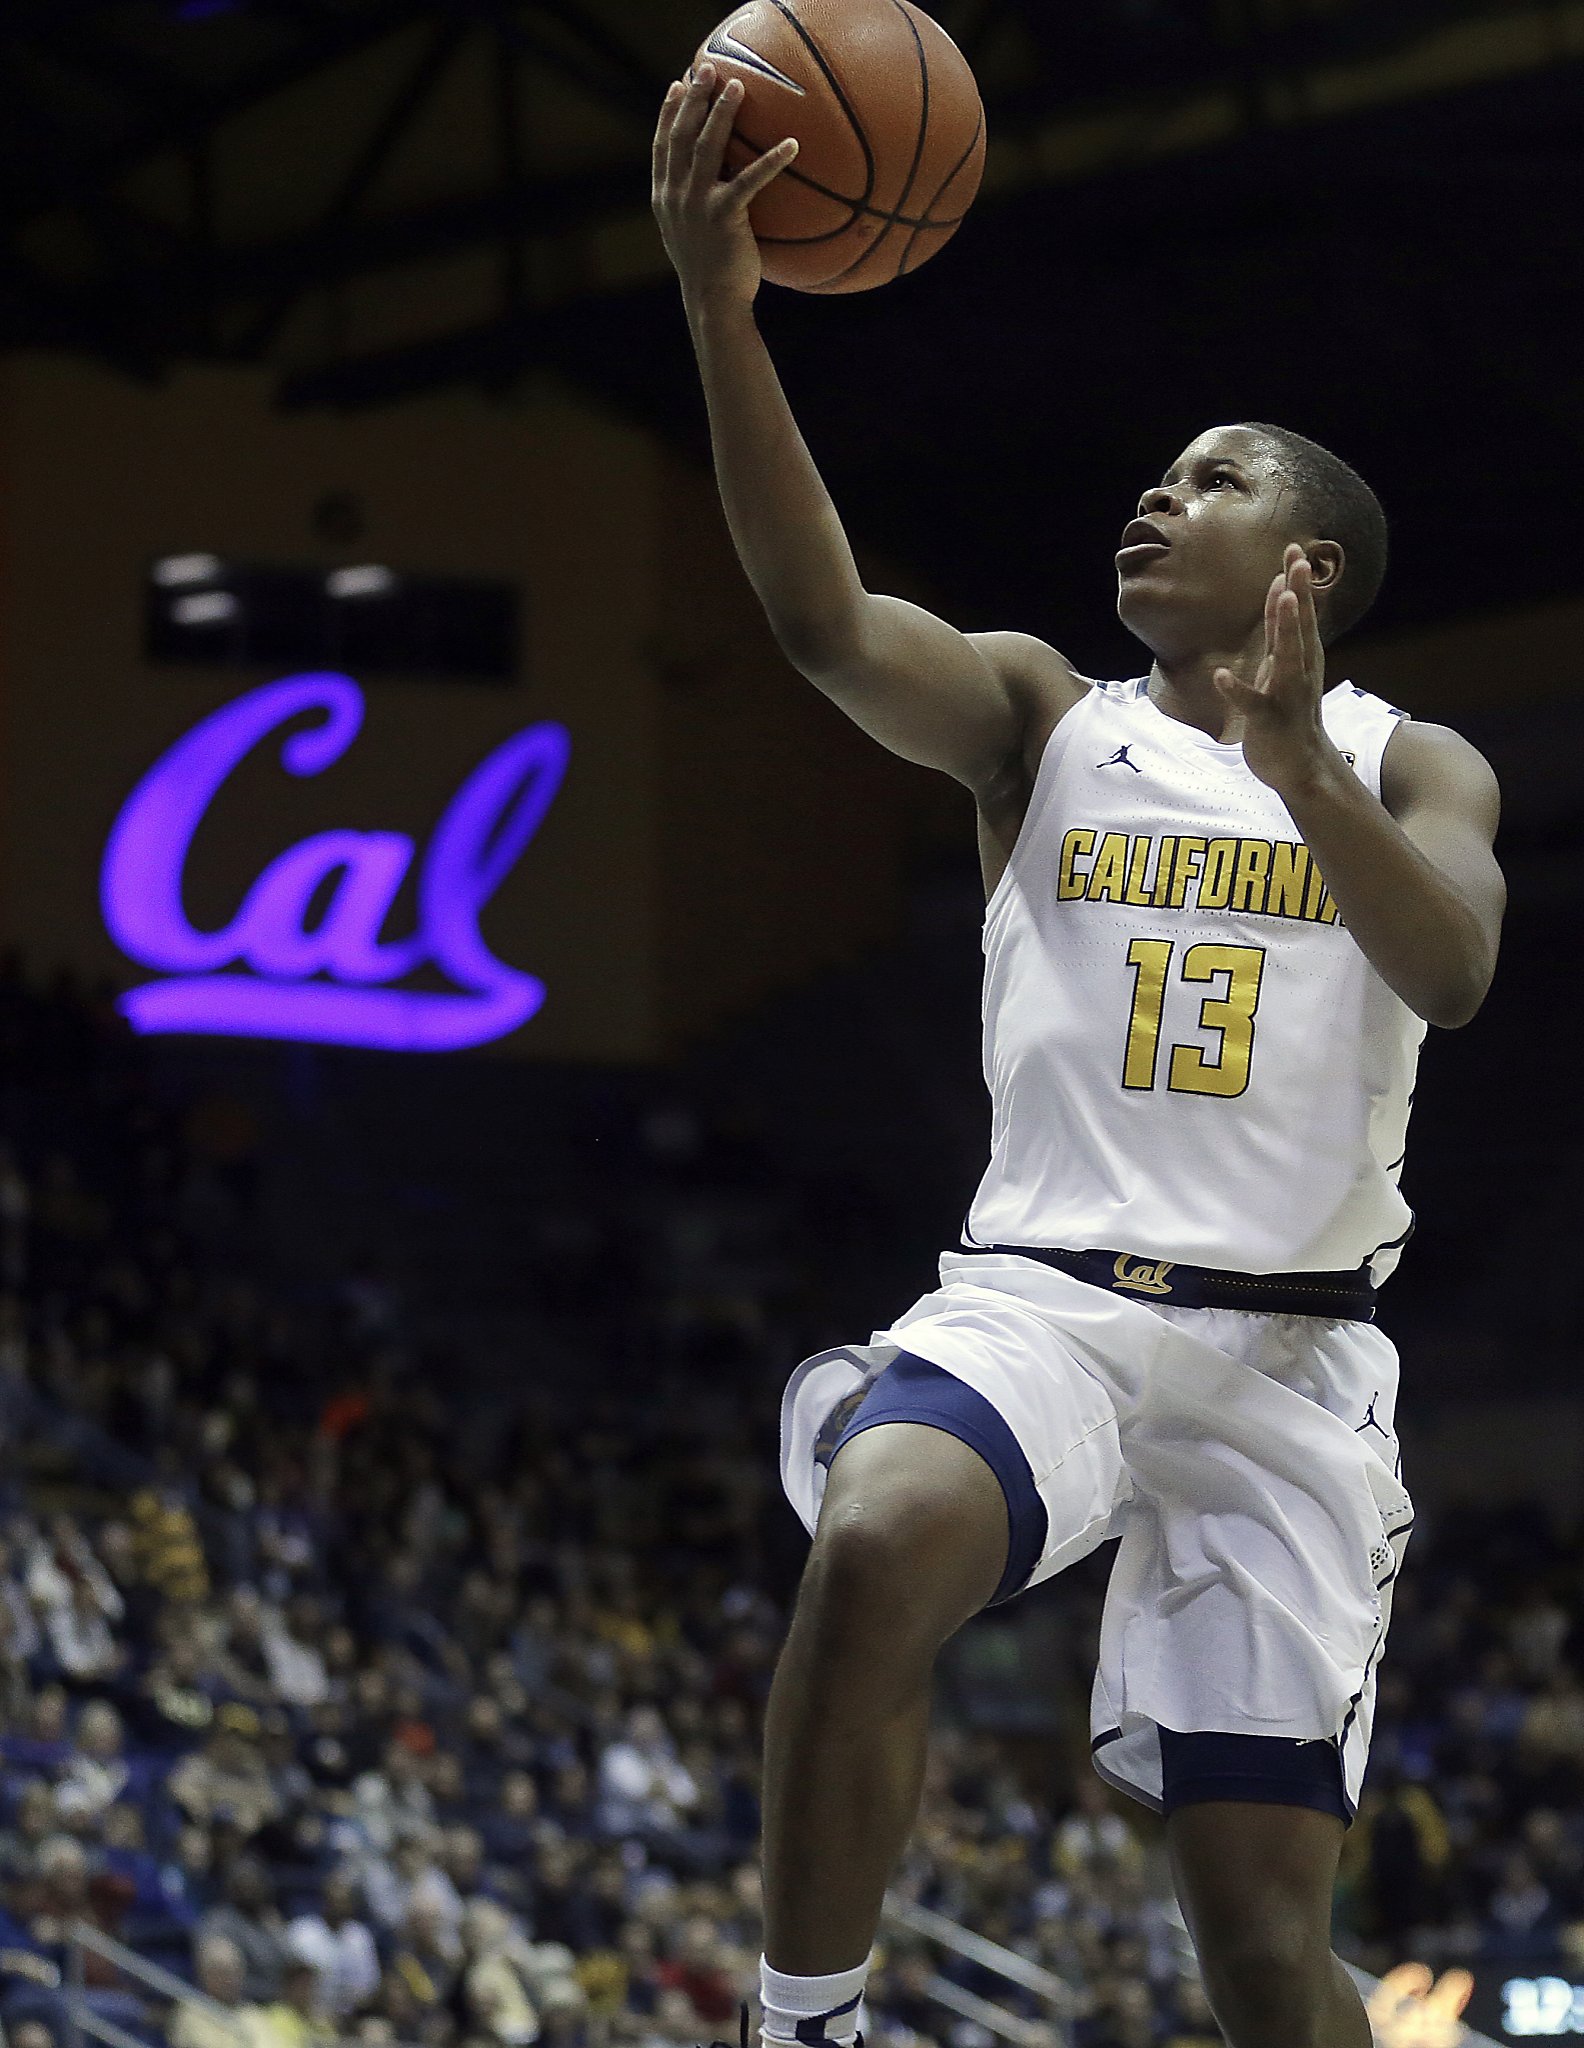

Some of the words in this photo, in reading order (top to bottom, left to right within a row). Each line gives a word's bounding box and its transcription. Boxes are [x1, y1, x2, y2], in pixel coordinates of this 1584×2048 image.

[99, 670, 572, 1052] Cal
[1121, 938, 1266, 1099] 13
[1112, 1253, 1175, 1294] Cal
